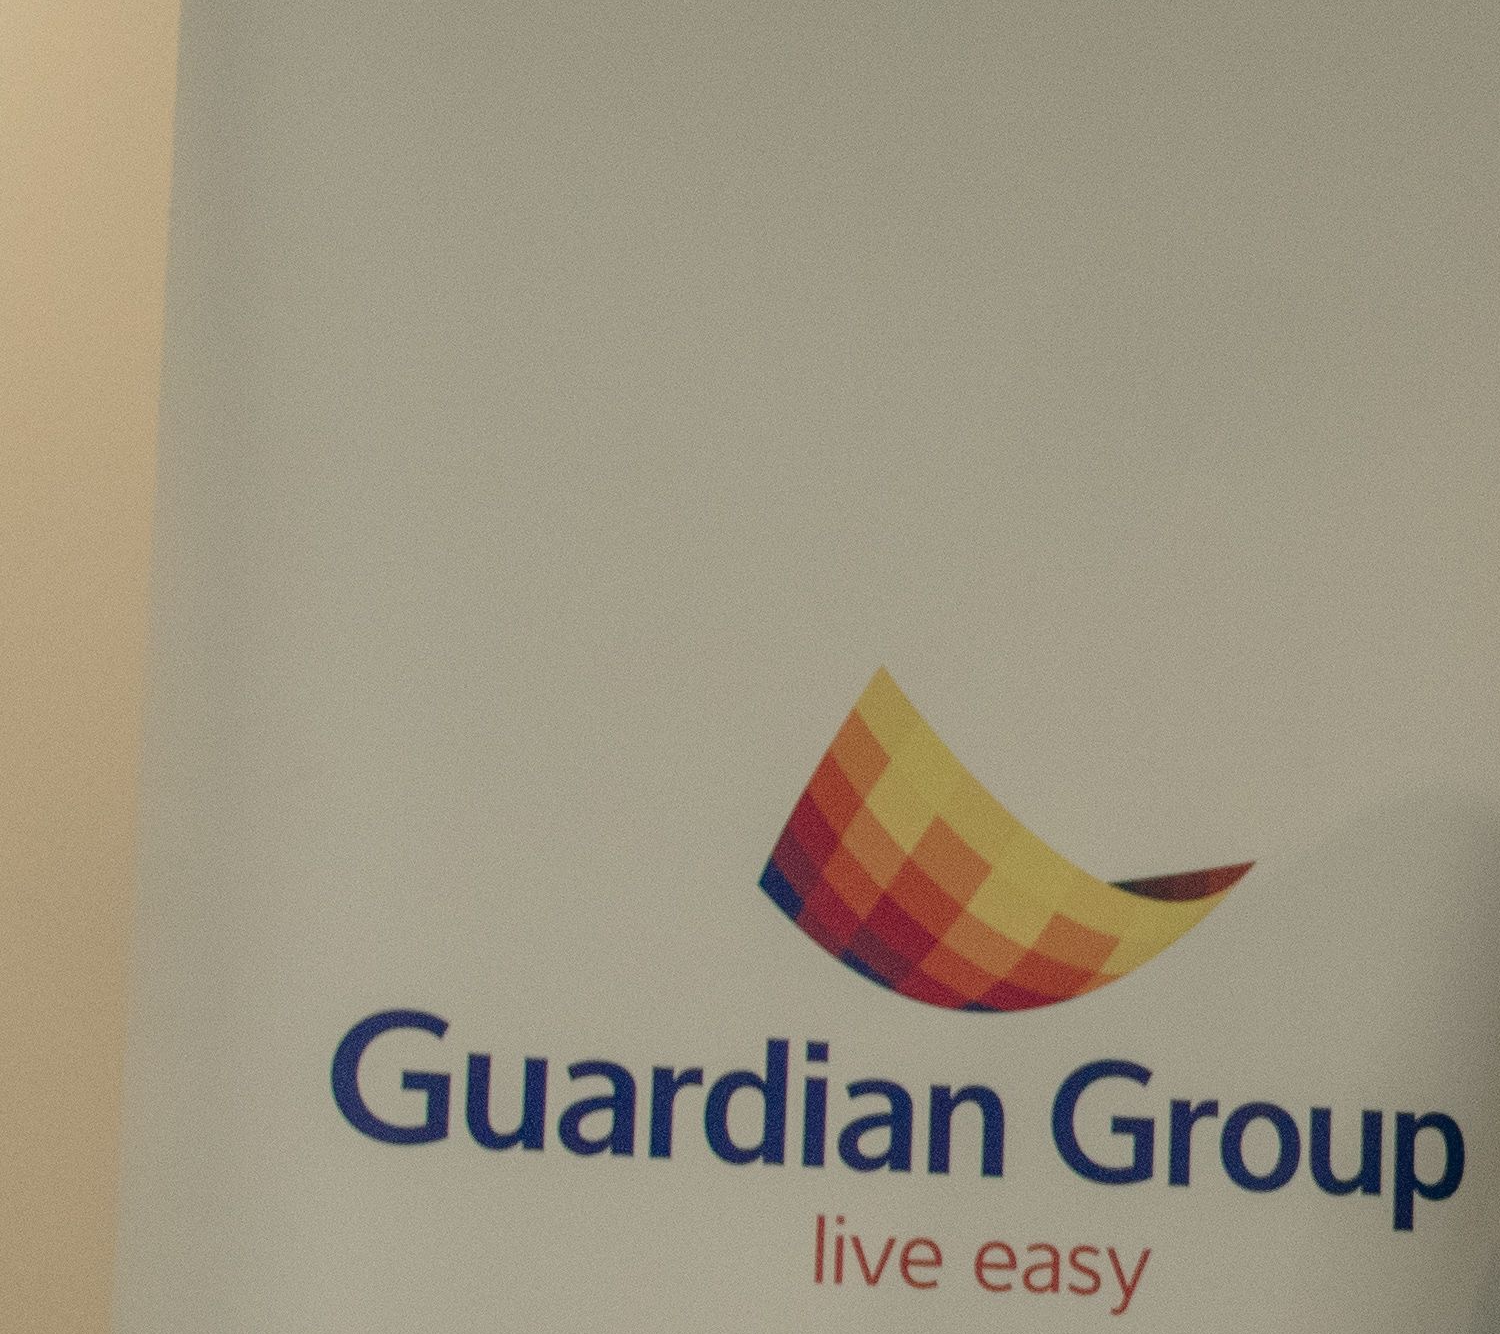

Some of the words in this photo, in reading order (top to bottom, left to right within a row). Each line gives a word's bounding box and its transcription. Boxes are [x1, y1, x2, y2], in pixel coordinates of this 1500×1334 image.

[329, 1008, 1007, 1179] Guardian
[1049, 1058, 1466, 1231] Group
[813, 1213, 943, 1289] live
[974, 1232, 1151, 1315] easy
